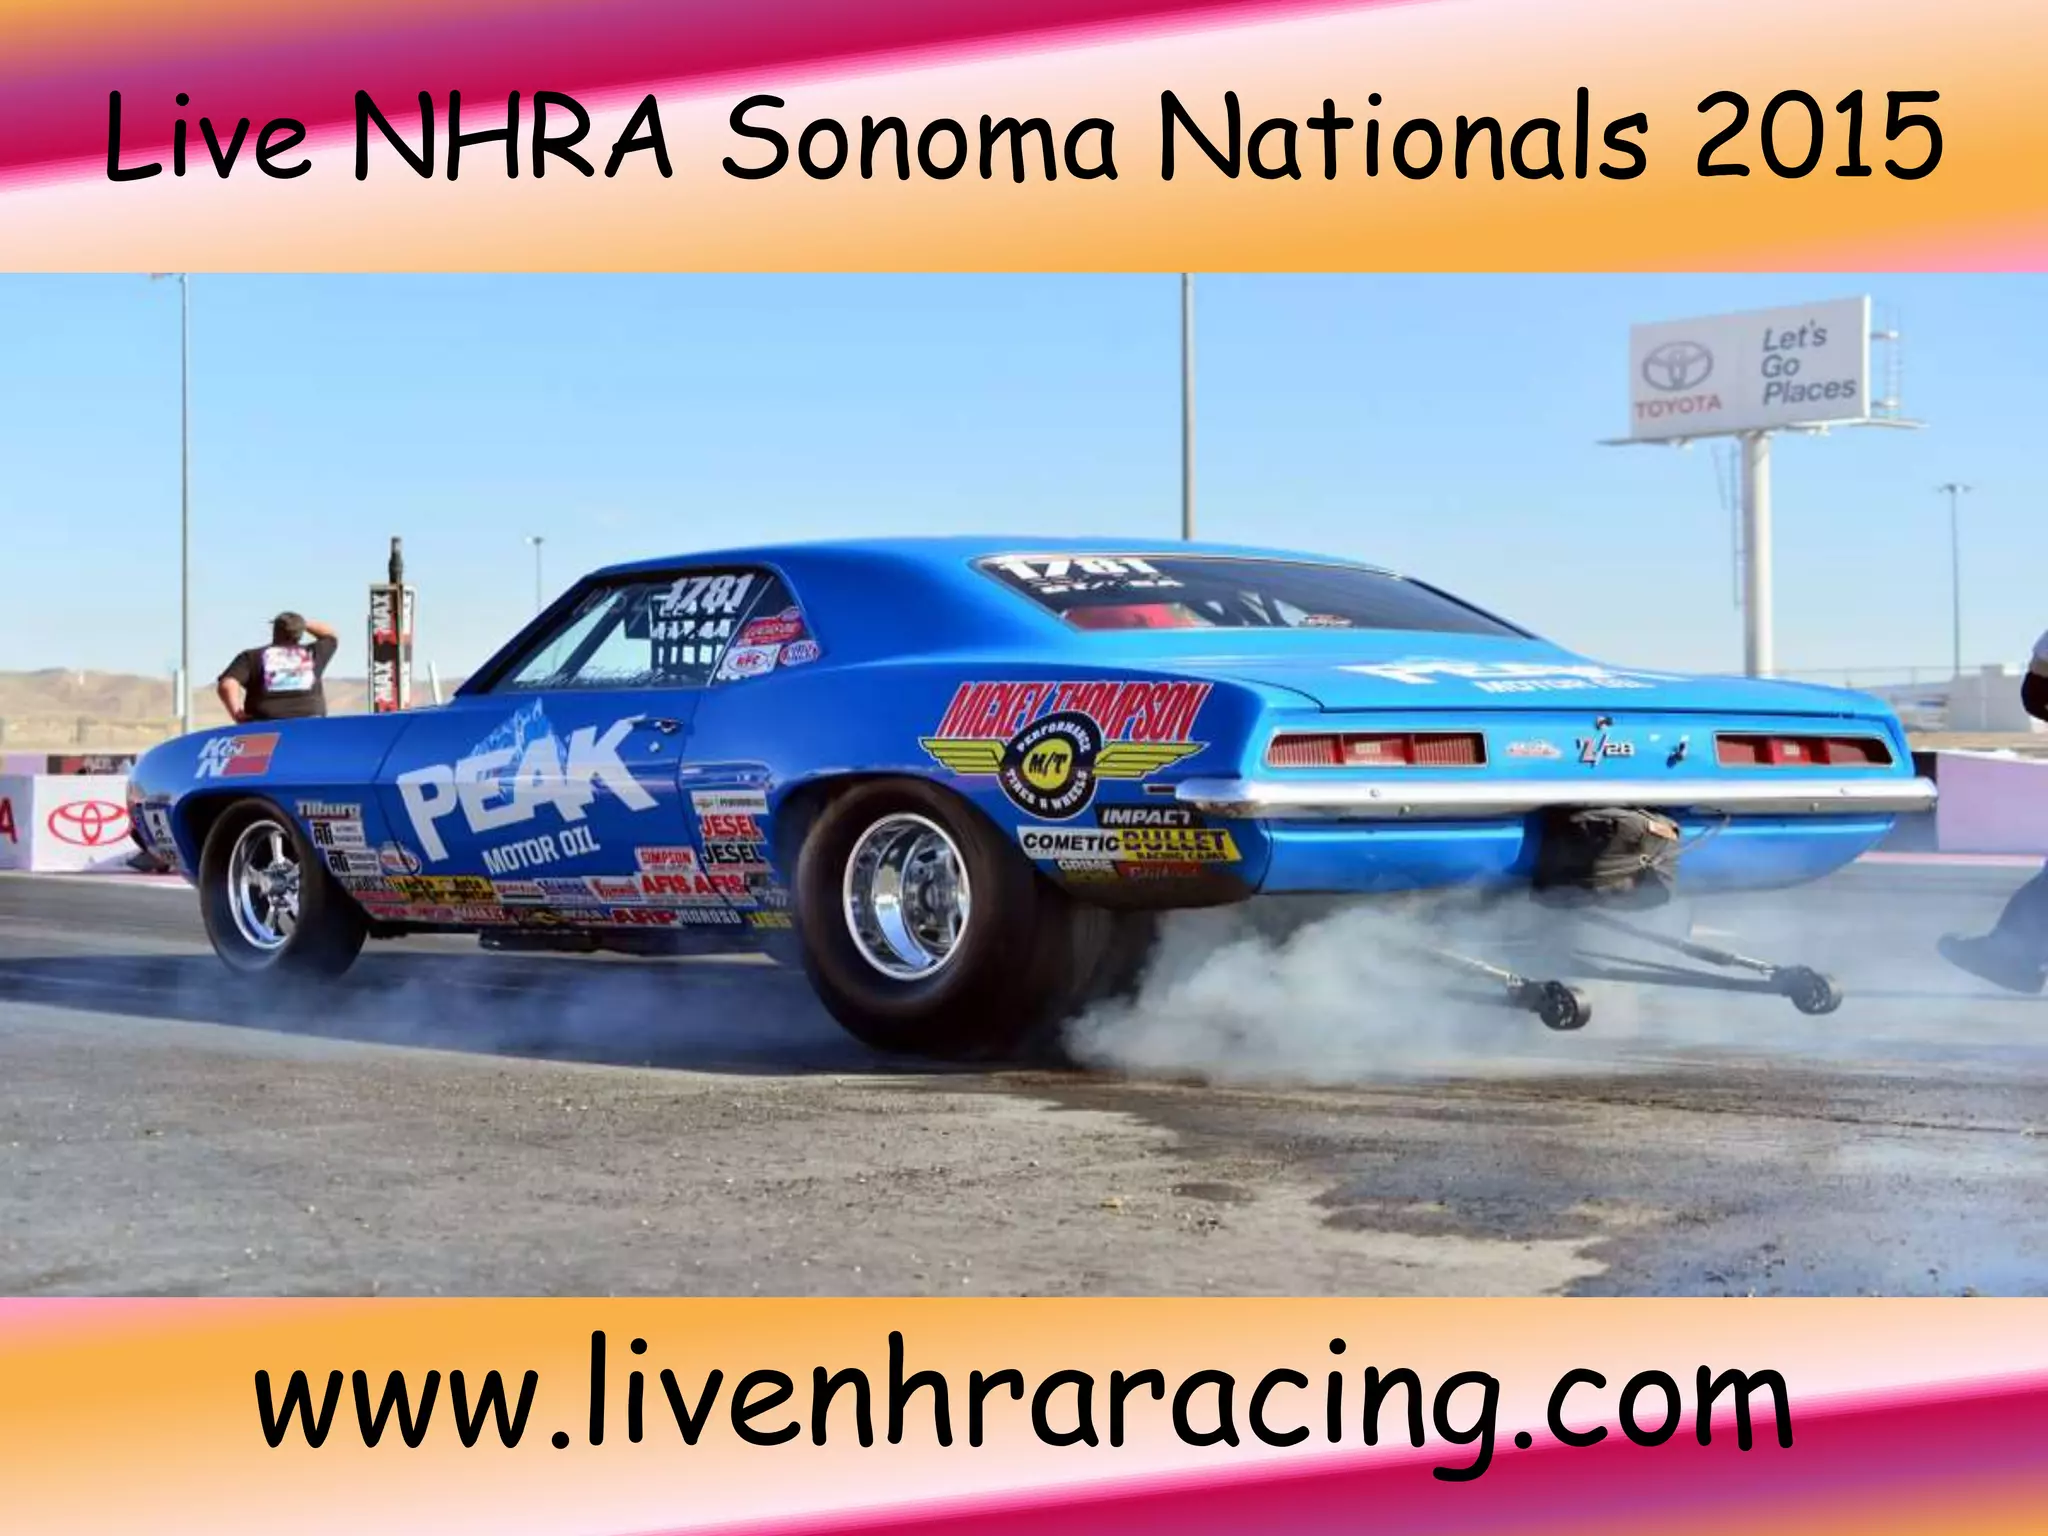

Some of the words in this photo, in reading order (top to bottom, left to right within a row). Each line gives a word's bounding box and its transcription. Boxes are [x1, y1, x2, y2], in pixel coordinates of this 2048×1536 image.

[1762, 319, 1828, 353] Let's
[1761, 354, 1800, 378] Go
[1762, 379, 1857, 405] Places
[1635, 394, 1722, 419] TOYOTA
[662, 573, 755, 614] 1781
[934, 681, 1058, 744] MICKEY
[1049, 681, 1215, 744] THOMPSON
[1015, 720, 1092, 754] PERFORMANCE
[1028, 750, 1066, 775] M/T
[396, 713, 660, 863] PEAK
[702, 814, 760, 836] JESEL
[482, 833, 561, 875] MOTOR
[559, 825, 601, 857] OIL
[1023, 832, 1120, 851] COMETIC
[1121, 829, 1227, 851] BULLET
[641, 851, 693, 864] SIMPSON
[703, 843, 766, 864] JESEL
